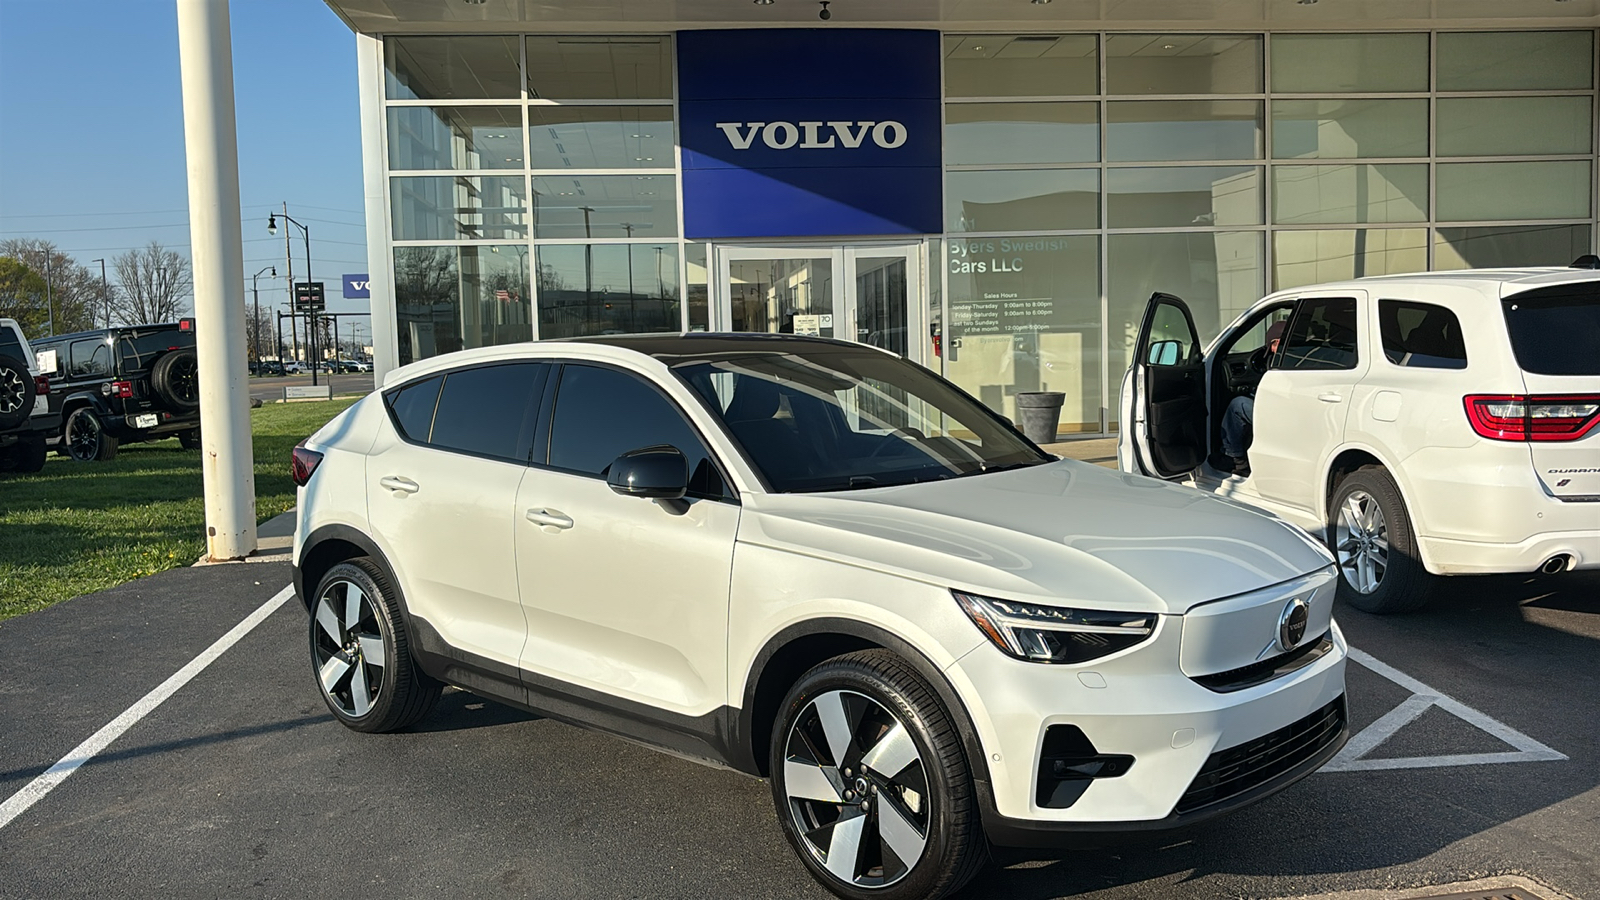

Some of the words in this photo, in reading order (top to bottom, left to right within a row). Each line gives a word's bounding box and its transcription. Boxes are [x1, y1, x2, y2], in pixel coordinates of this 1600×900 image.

[716, 120, 908, 150] VOLVO
[950, 240, 995, 257] Byers
[1000, 239, 1068, 253] Swedish
[950, 258, 987, 274] Cars
[991, 257, 1023, 273] LLC
[1032, 301, 1053, 309] 8:00pm
[954, 311, 999, 319] Friday-Saturday
[1032, 309, 1053, 317] 6:00pm
[974, 319, 999, 327] Sundays
[884, 689, 915, 719] ZERO
